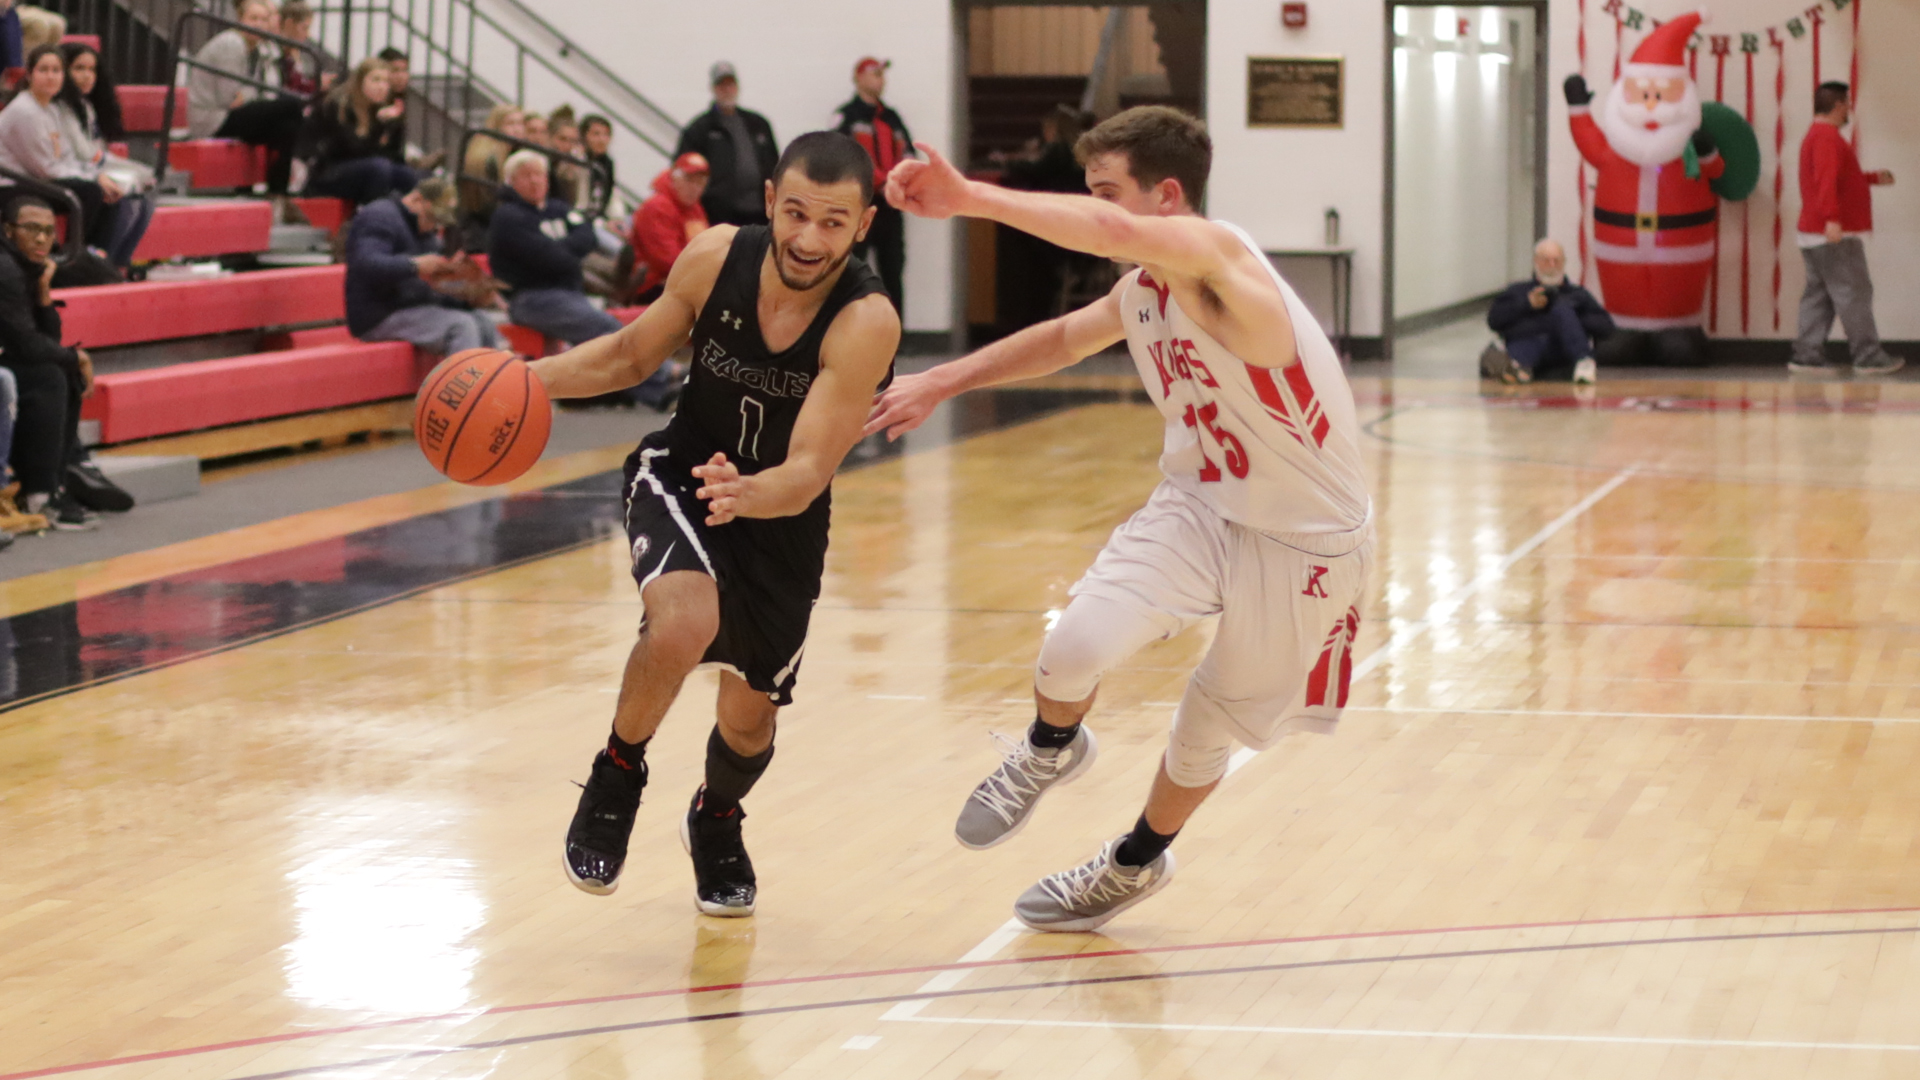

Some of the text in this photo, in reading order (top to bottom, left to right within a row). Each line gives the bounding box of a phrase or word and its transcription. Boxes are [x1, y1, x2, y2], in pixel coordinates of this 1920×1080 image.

[700, 338, 811, 398] EAGLES
[1147, 337, 1221, 400] KGS
[426, 366, 484, 451] THE ROCK
[489, 418, 515, 455] ROCK
[740, 396, 764, 461] 1
[1182, 401, 1249, 482] 15
[1302, 564, 1329, 599] K
